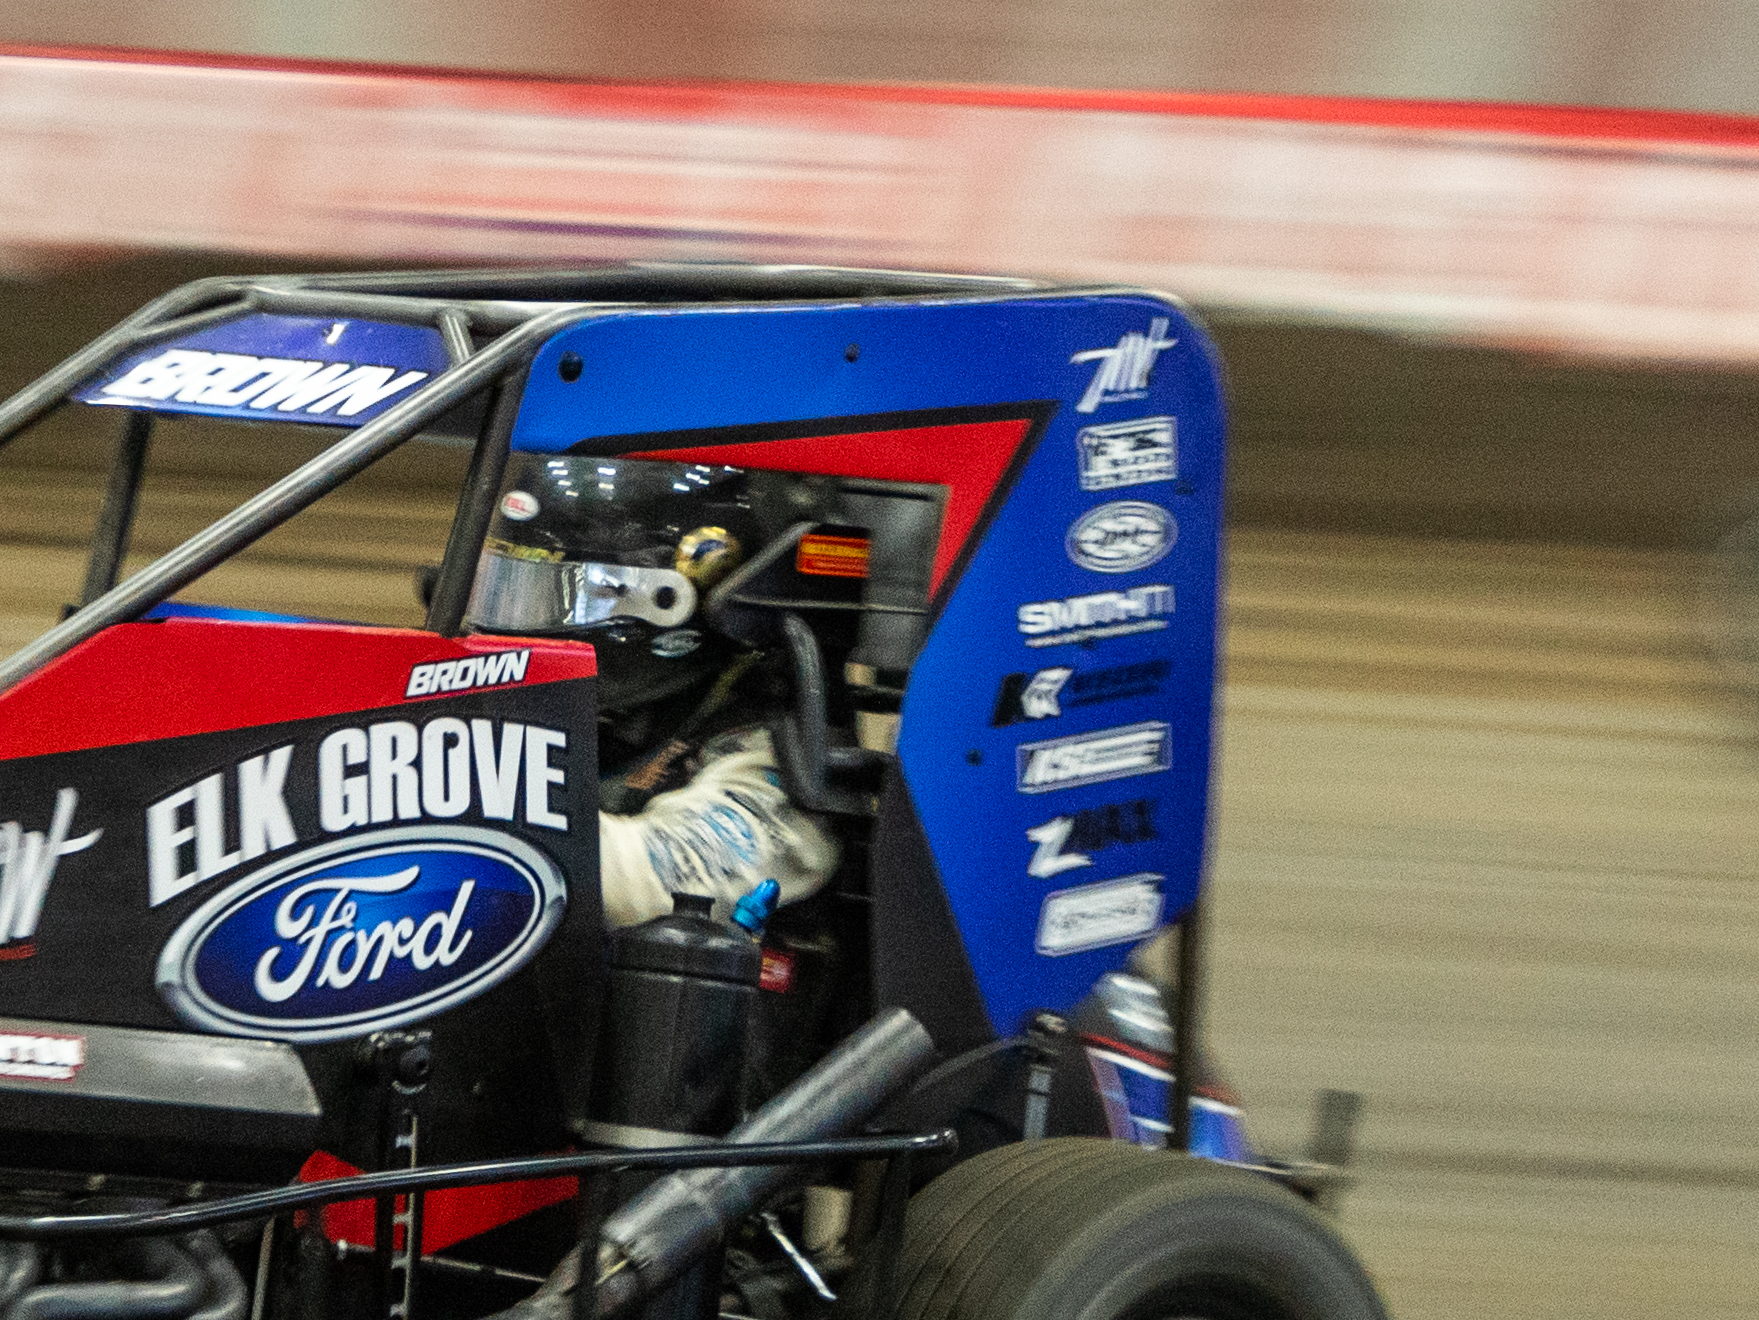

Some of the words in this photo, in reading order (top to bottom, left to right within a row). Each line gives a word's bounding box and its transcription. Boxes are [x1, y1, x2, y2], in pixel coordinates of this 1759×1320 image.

[101, 348, 430, 417] BROWN
[405, 648, 531, 697] BROWN
[146, 744, 299, 909] ELK
[318, 716, 569, 833] GROVE
[253, 865, 477, 1003] Ford
